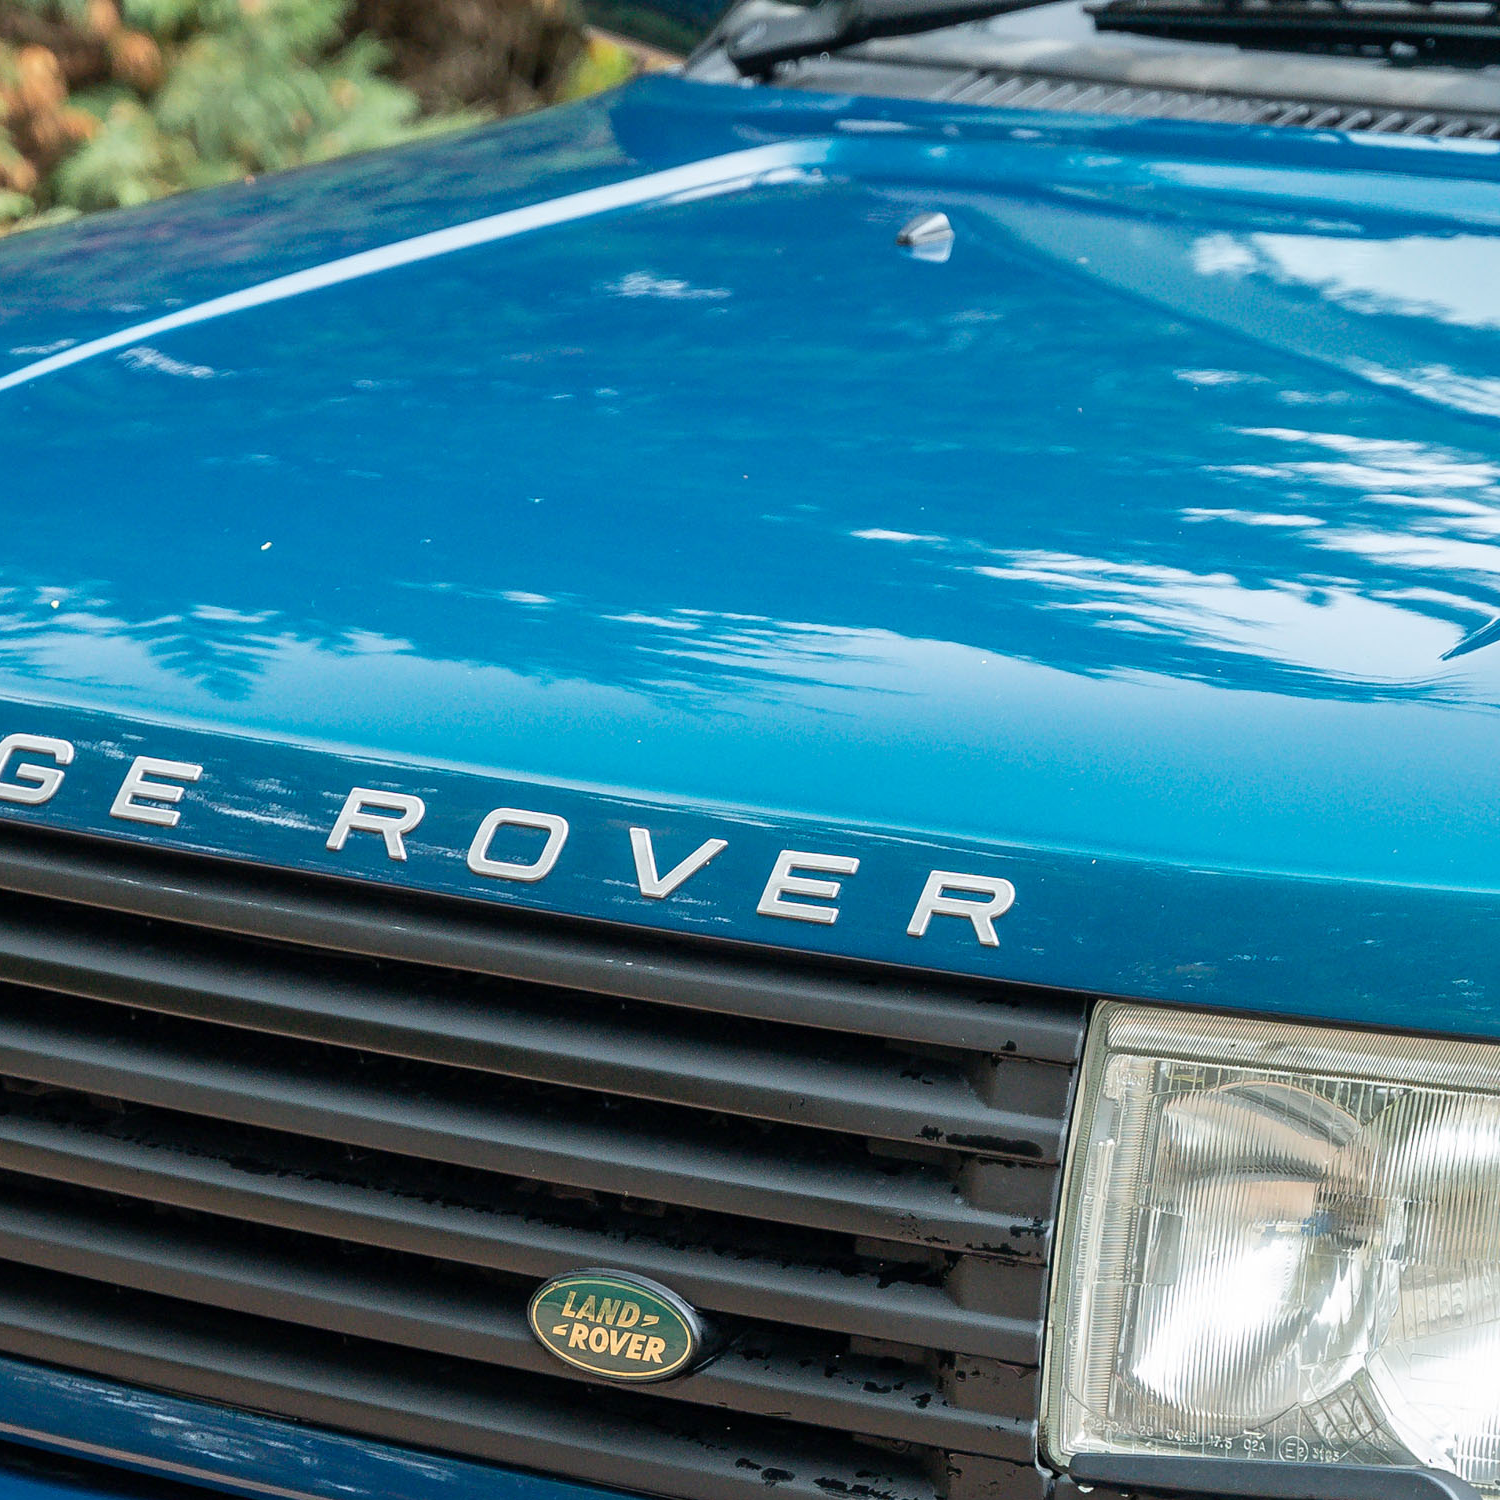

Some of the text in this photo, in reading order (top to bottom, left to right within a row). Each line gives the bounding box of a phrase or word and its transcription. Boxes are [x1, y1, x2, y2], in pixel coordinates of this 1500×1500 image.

[326, 786, 1016, 947] ROVER
[561, 1290, 641, 1328] LAND
[567, 1322, 666, 1364] ROVER
[1243, 1438, 1266, 1453] 02A
